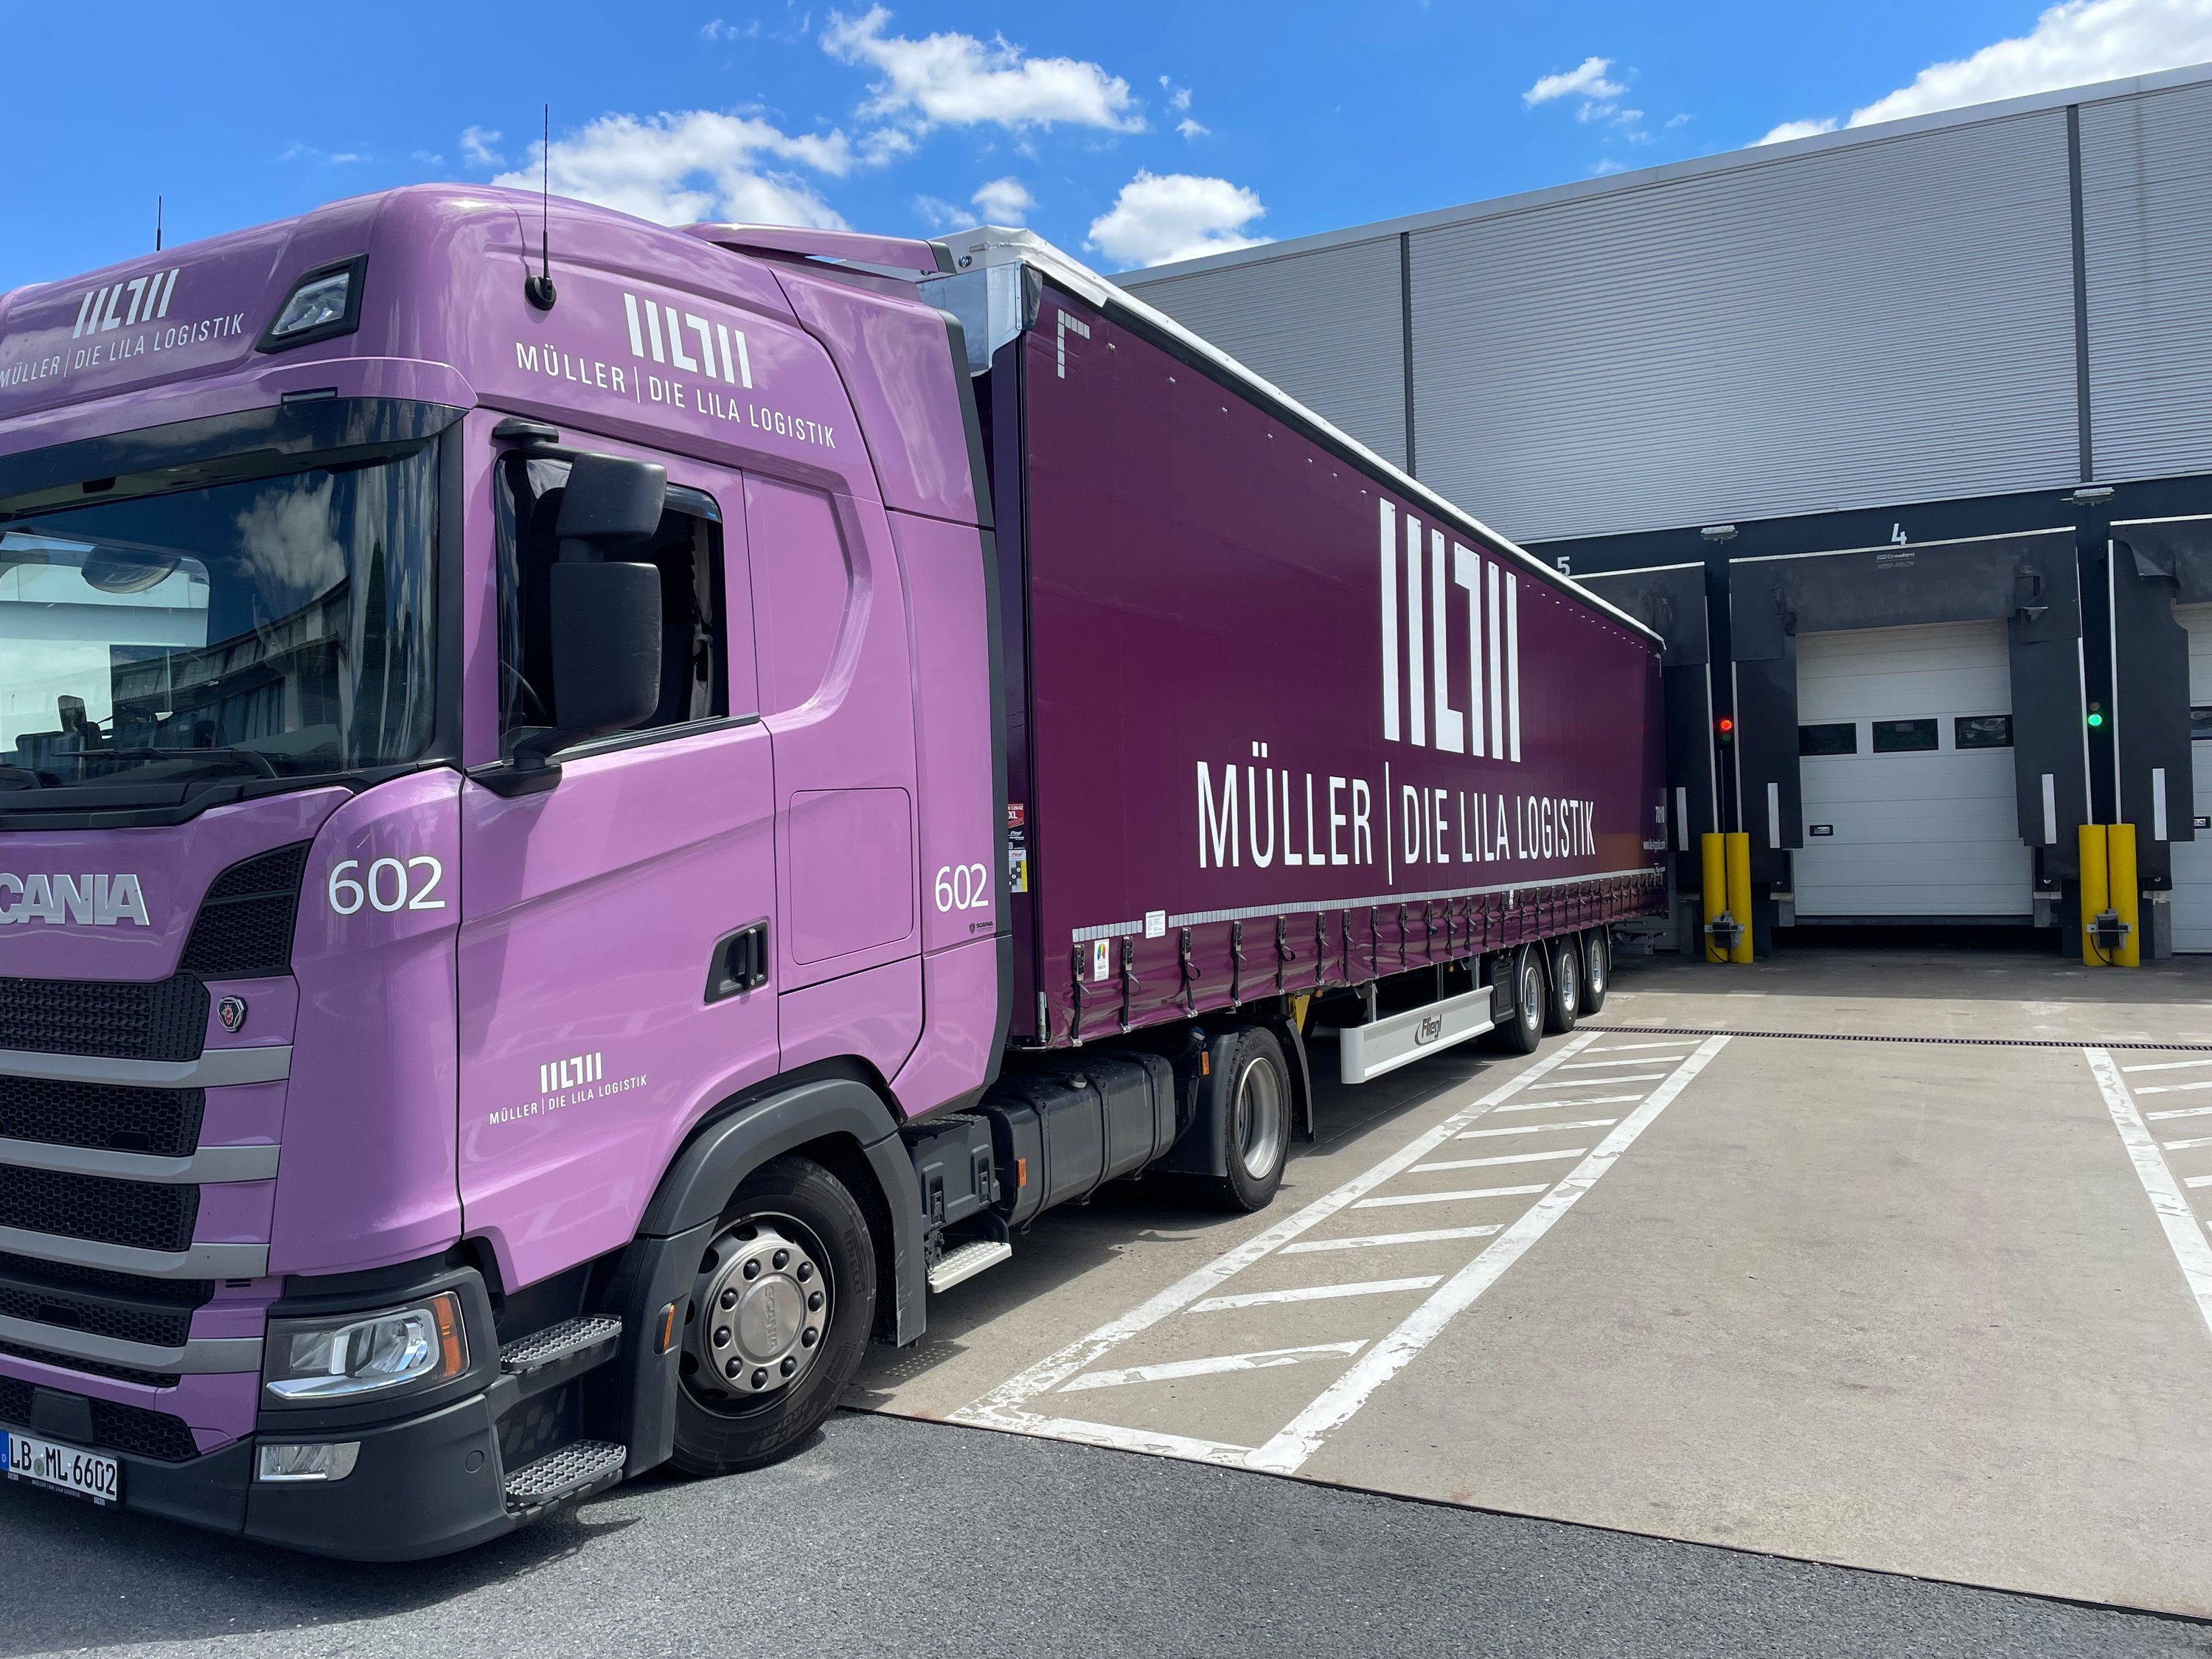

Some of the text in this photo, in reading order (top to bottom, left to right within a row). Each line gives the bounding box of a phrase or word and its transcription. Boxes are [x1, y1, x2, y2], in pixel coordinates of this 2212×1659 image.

[0, 313, 244, 388] MÜLLER DIE LILA LOGISTIK
[515, 341, 836, 449] MÜLLER DIE LILA LOGISTIK
[1891, 523, 1907, 546] 4
[1557, 556, 1571, 577] 5
[1197, 741, 1596, 869] MÜLLER DIE LILA LOGISTIK
[329, 856, 445, 915] 602
[935, 863, 989, 913] 602
[489, 1074, 647, 1125] MÜLLER DIE LILA LOGISTIK
[1, 1453, 7, 1463] D
[10, 1438, 116, 1495] LB ML 6602
